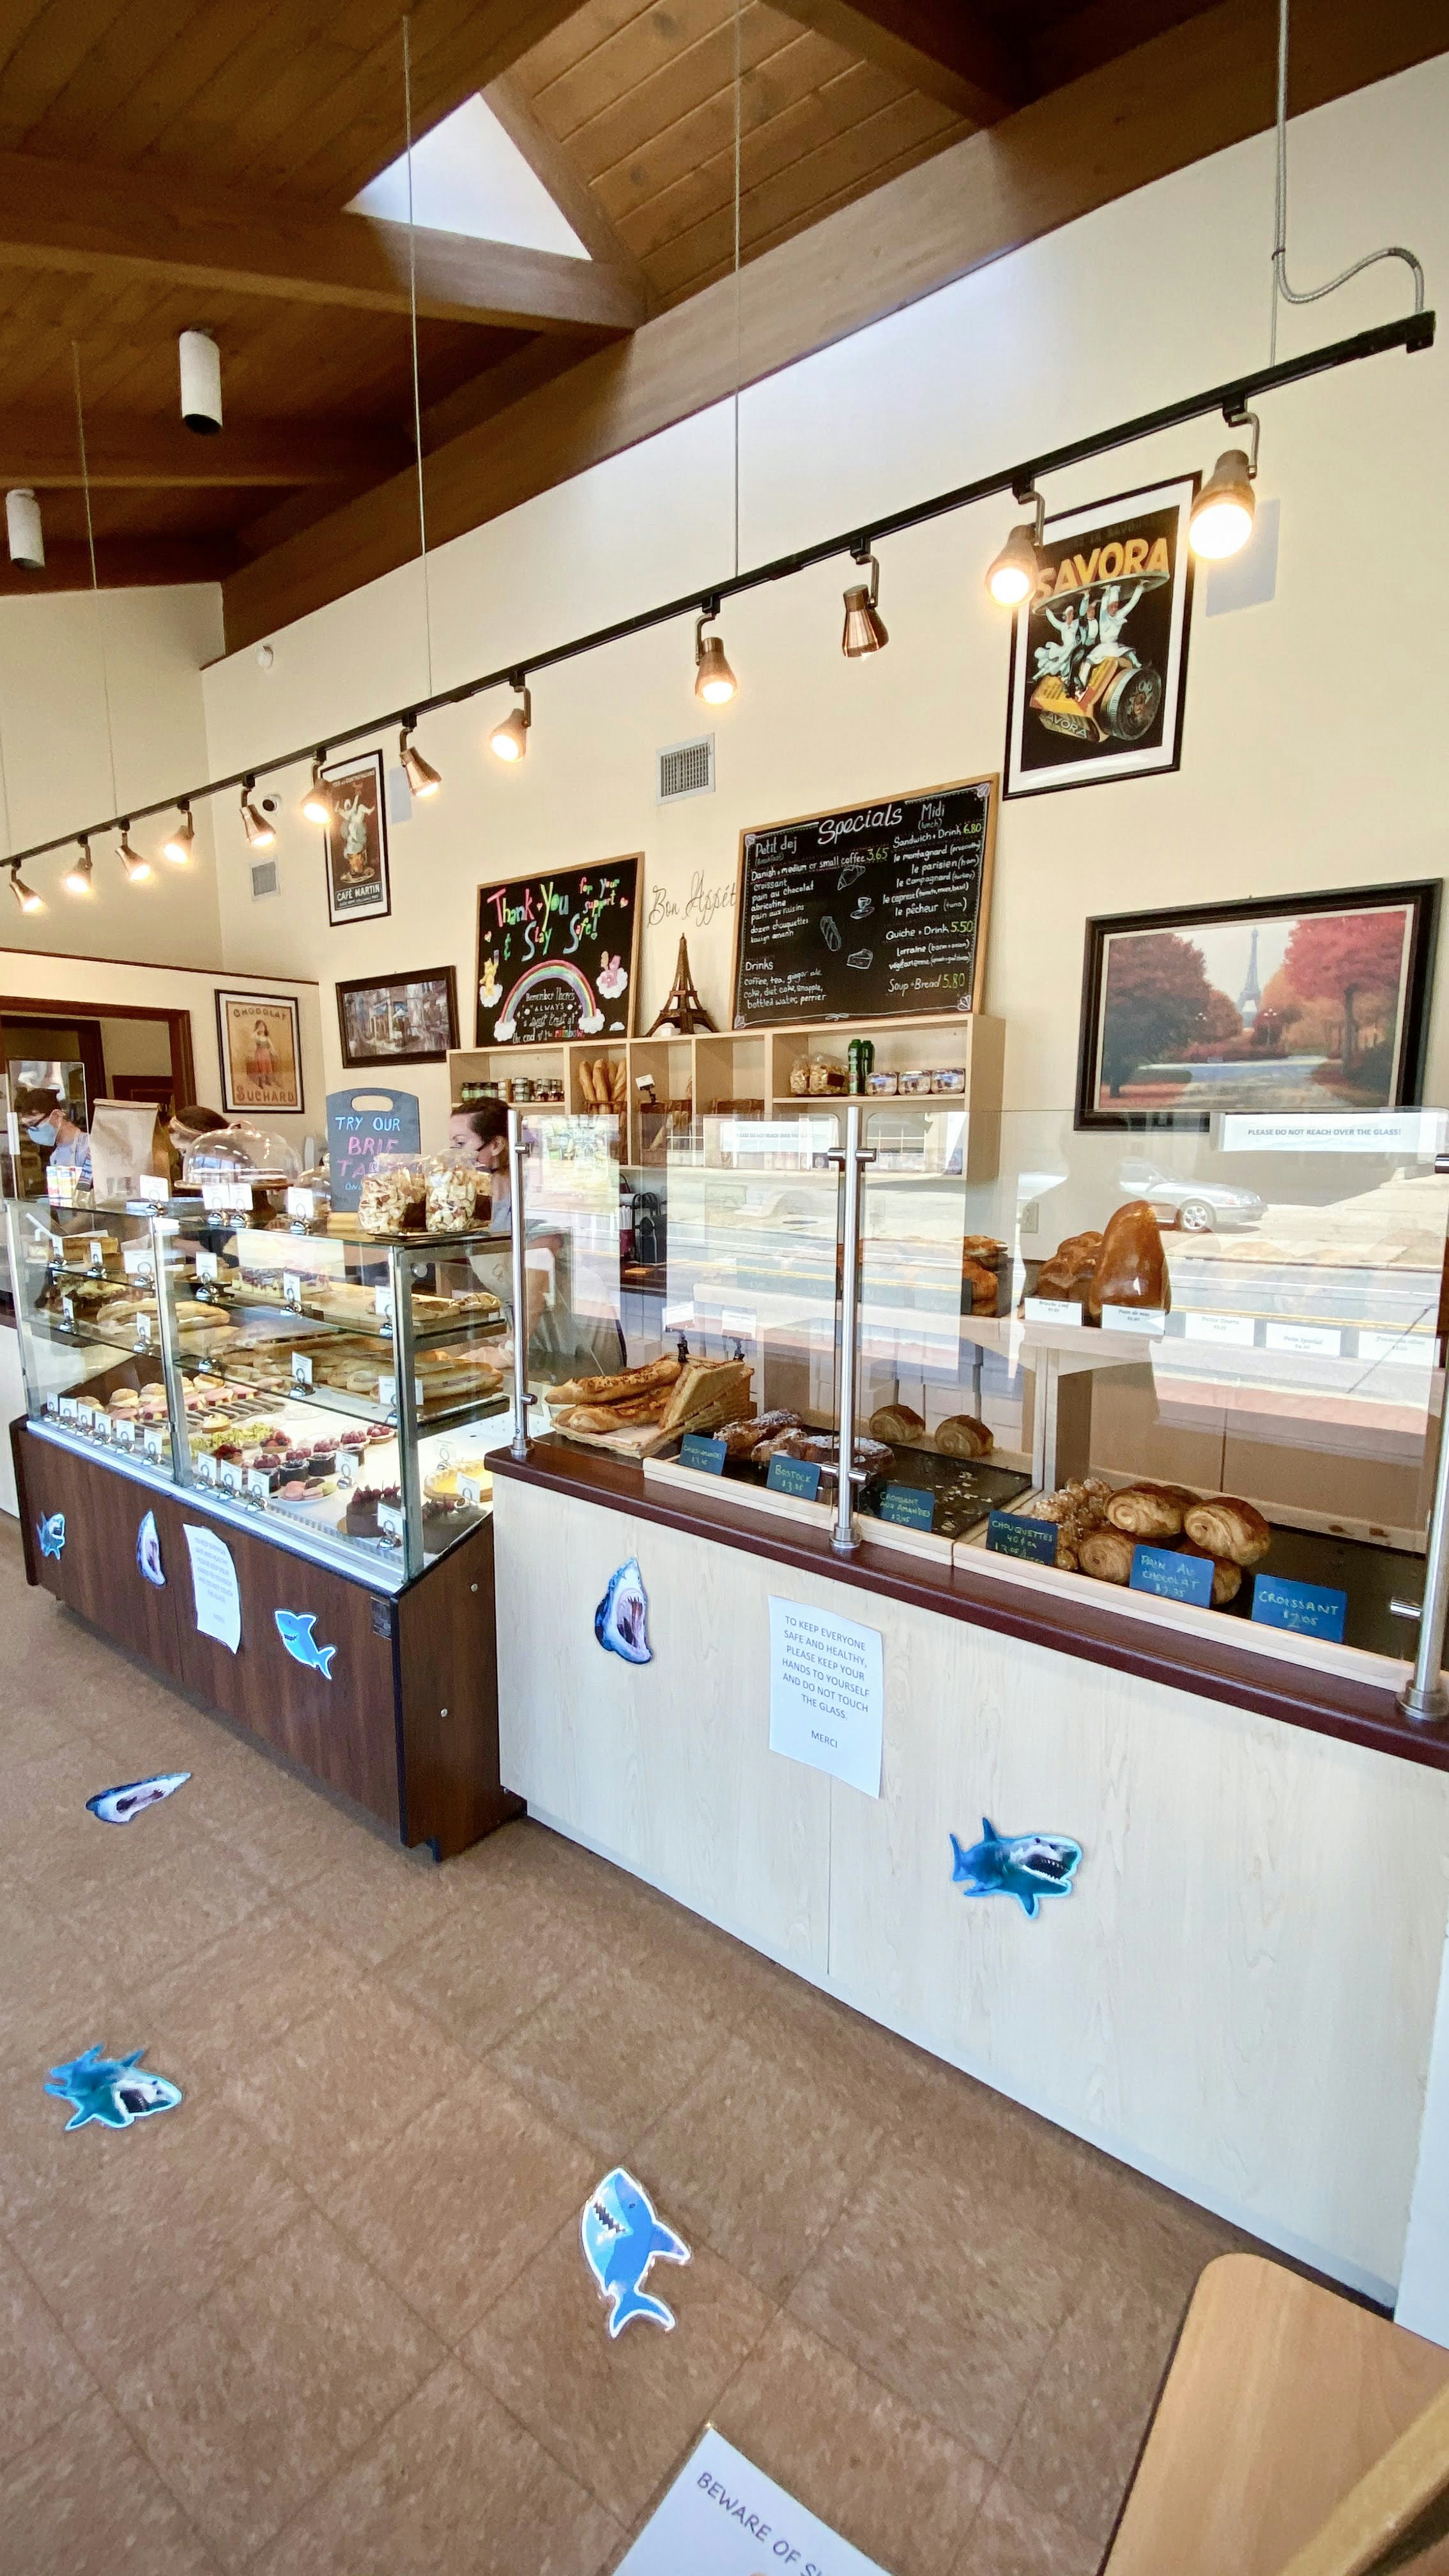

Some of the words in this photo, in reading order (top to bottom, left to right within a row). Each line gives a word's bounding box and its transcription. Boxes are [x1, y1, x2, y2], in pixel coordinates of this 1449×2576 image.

[1034, 537, 1170, 599] SAVORA
[921, 801, 945, 820] Midi
[818, 804, 902, 844] Specials
[893, 833, 931, 848] Sandwich
[938, 824, 962, 839] Drink
[963, 823, 981, 834] 6.80
[756, 836, 778, 857] Petit
[780, 835, 797, 854] dej
[894, 854, 900, 862] le
[903, 845, 947, 861] montagnard
[751, 865, 776, 881] Danish
[819, 856, 839, 868] small
[841, 852, 865, 866] coffee
[866, 847, 889, 861] 3.65
[912, 864, 919, 874] le
[922, 860, 957, 875] parisien
[355, 884, 379, 897] MARTIN
[579, 877, 593, 894] for
[600, 878, 620, 898] your
[754, 878, 788, 891] croissant
[896, 878, 903, 887] le
[487, 888, 535, 927] Thank
[540, 882, 569, 931] You
[583, 889, 616, 917] support
[647, 885, 680, 928] Bon
[751, 900, 786, 912] abricotine
[752, 892, 767, 905] pain
[770, 889, 780, 898] au
[883, 894, 890, 905] le
[751, 912, 767, 924] pain
[783, 904, 804, 916] raisins
[895, 907, 903, 916] le
[521, 921, 553, 962] Stay
[562, 913, 598, 954] Safe!
[751, 925, 770, 933] dozen
[885, 928, 916, 940] Quiche
[924, 924, 949, 935] Drink
[951, 921, 973, 933] 5.50
[746, 958, 774, 971] Drinks
[888, 979, 909, 997] Soup
[914, 974, 942, 990] Bread
[942, 973, 965, 988] 5.80
[535, 1003, 564, 1012] ALWAYS
[747, 997, 773, 1009] bottled
[801, 995, 827, 1006] perrier
[233, 1009, 286, 1021] CHOCOLAT
[523, 1027, 535, 1043] end
[236, 1085, 294, 1102] SUCHARD
[335, 1116, 363, 1131] TRY
[372, 1117, 401, 1131] OUR
[775, 1464, 811, 1482] BOSTOCK
[1259, 1590, 1339, 1615] CROISSANT
[785, 1615, 797, 1626] TO
[799, 1620, 819, 1633] KEEP
[821, 1628, 866, 1652] EVERYONE
[784, 1630, 804, 1644] SAFE
[806, 1637, 824, 1651] AND
[826, 1644, 868, 1668] HEALTHY,
[786, 1645, 816, 1663] PLEASE
[818, 1656, 838, 1671] KEEP
[840, 1665, 865, 1681] YOUR
[782, 1658, 811, 1676] HANDS
[813, 1669, 824, 1680] TO
[826, 1674, 870, 1698] YOURSELF
[783, 1672, 801, 1686] AND
[802, 1680, 815, 1692] DO
[817, 1686, 836, 1700] NOT
[838, 1693, 869, 1713] TOUCH
[801, 1693, 817, 1707] THE
[819, 1701, 848, 1721] GLASS.
[811, 1730, 838, 1749] MERCI
[696, 2472, 772, 2542] BEWARE
[772, 2540, 802, 2566] OF
